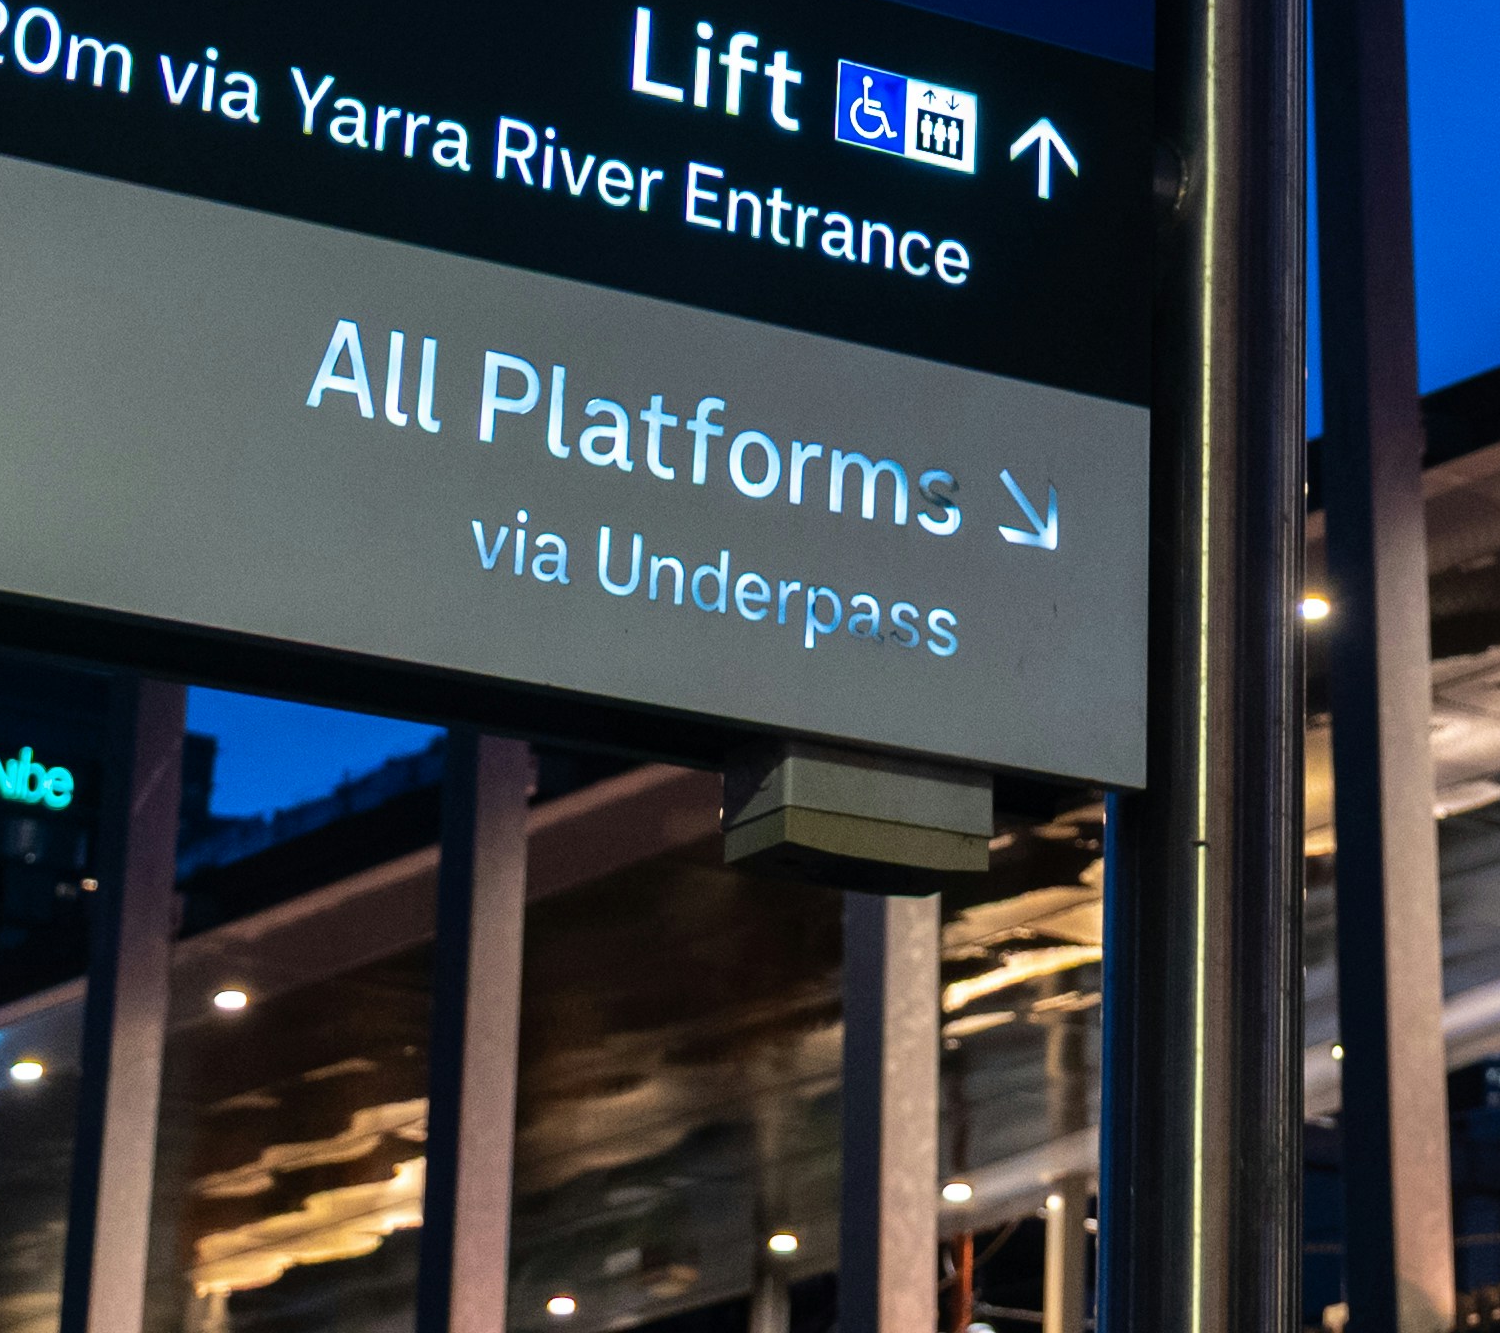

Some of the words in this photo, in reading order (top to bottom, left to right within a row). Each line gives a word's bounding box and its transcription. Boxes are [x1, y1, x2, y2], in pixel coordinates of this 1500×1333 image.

[630, 5, 803, 132] Lift
[158, 45, 262, 124] via
[289, 65, 472, 173] Yarra
[494, 114, 665, 213] River
[684, 160, 971, 286] Entrance
[304, 315, 444, 435] All
[476, 347, 965, 538] Platforms
[469, 506, 572, 588] via
[595, 523, 960, 659] Underpass
